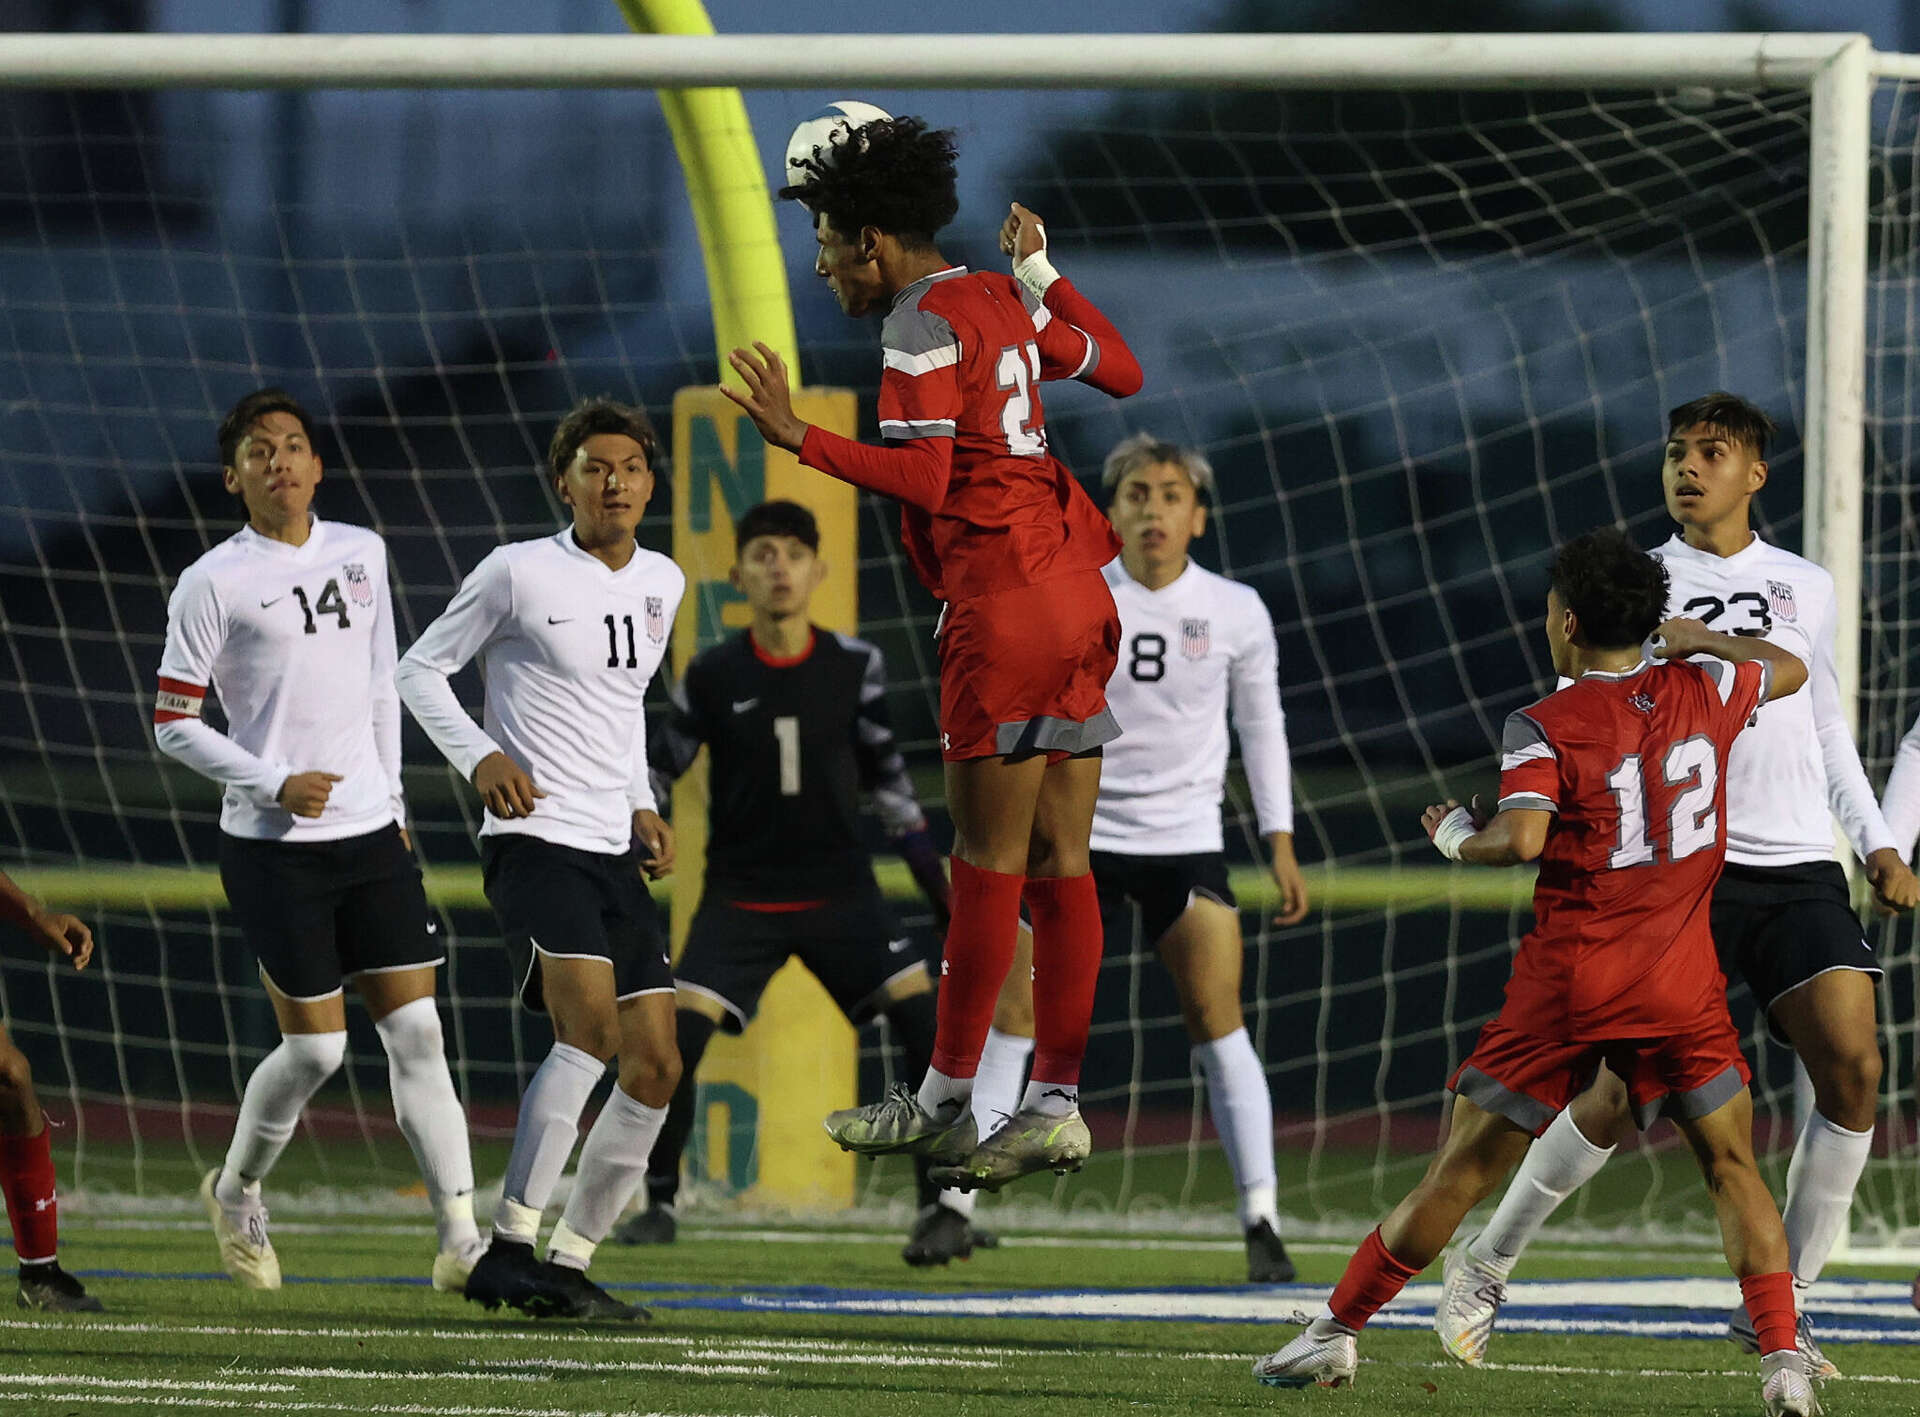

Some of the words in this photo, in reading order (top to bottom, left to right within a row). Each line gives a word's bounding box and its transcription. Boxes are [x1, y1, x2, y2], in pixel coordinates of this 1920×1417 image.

[293, 578, 351, 634] 14
[1683, 592, 1772, 638] 23
[604, 614, 637, 668] 11
[1130, 633, 1166, 682] 8
[774, 716, 801, 796] 1
[1606, 733, 1718, 869] 12
